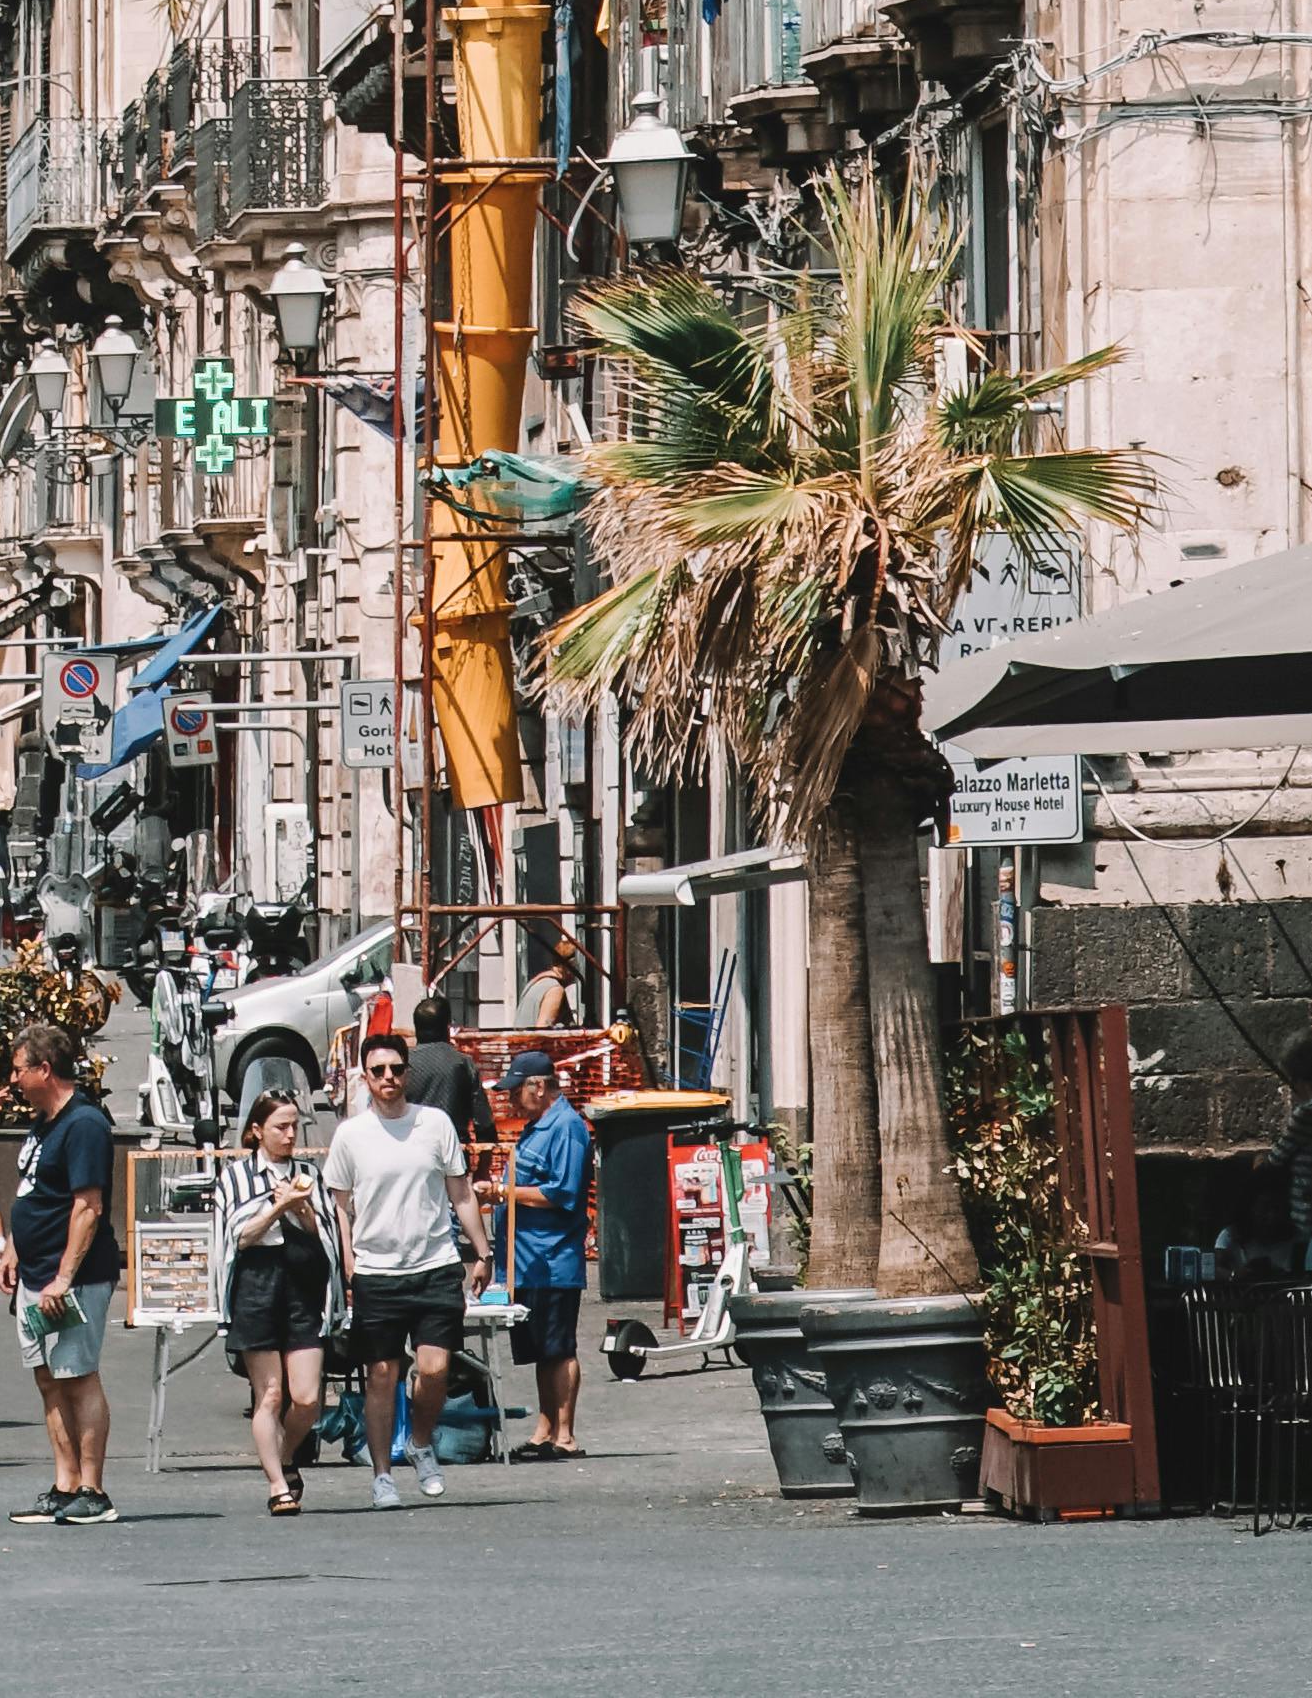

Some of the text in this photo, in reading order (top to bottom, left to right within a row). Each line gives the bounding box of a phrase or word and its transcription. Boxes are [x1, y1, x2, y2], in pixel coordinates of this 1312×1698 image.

[176, 399, 268, 435] E ALI
[955, 772, 1071, 794] alazzo Marletta
[953, 795, 1065, 816] Luxury House Hotel
[991, 817, 1002, 832] al
[1019, 816, 1026, 831] 7
